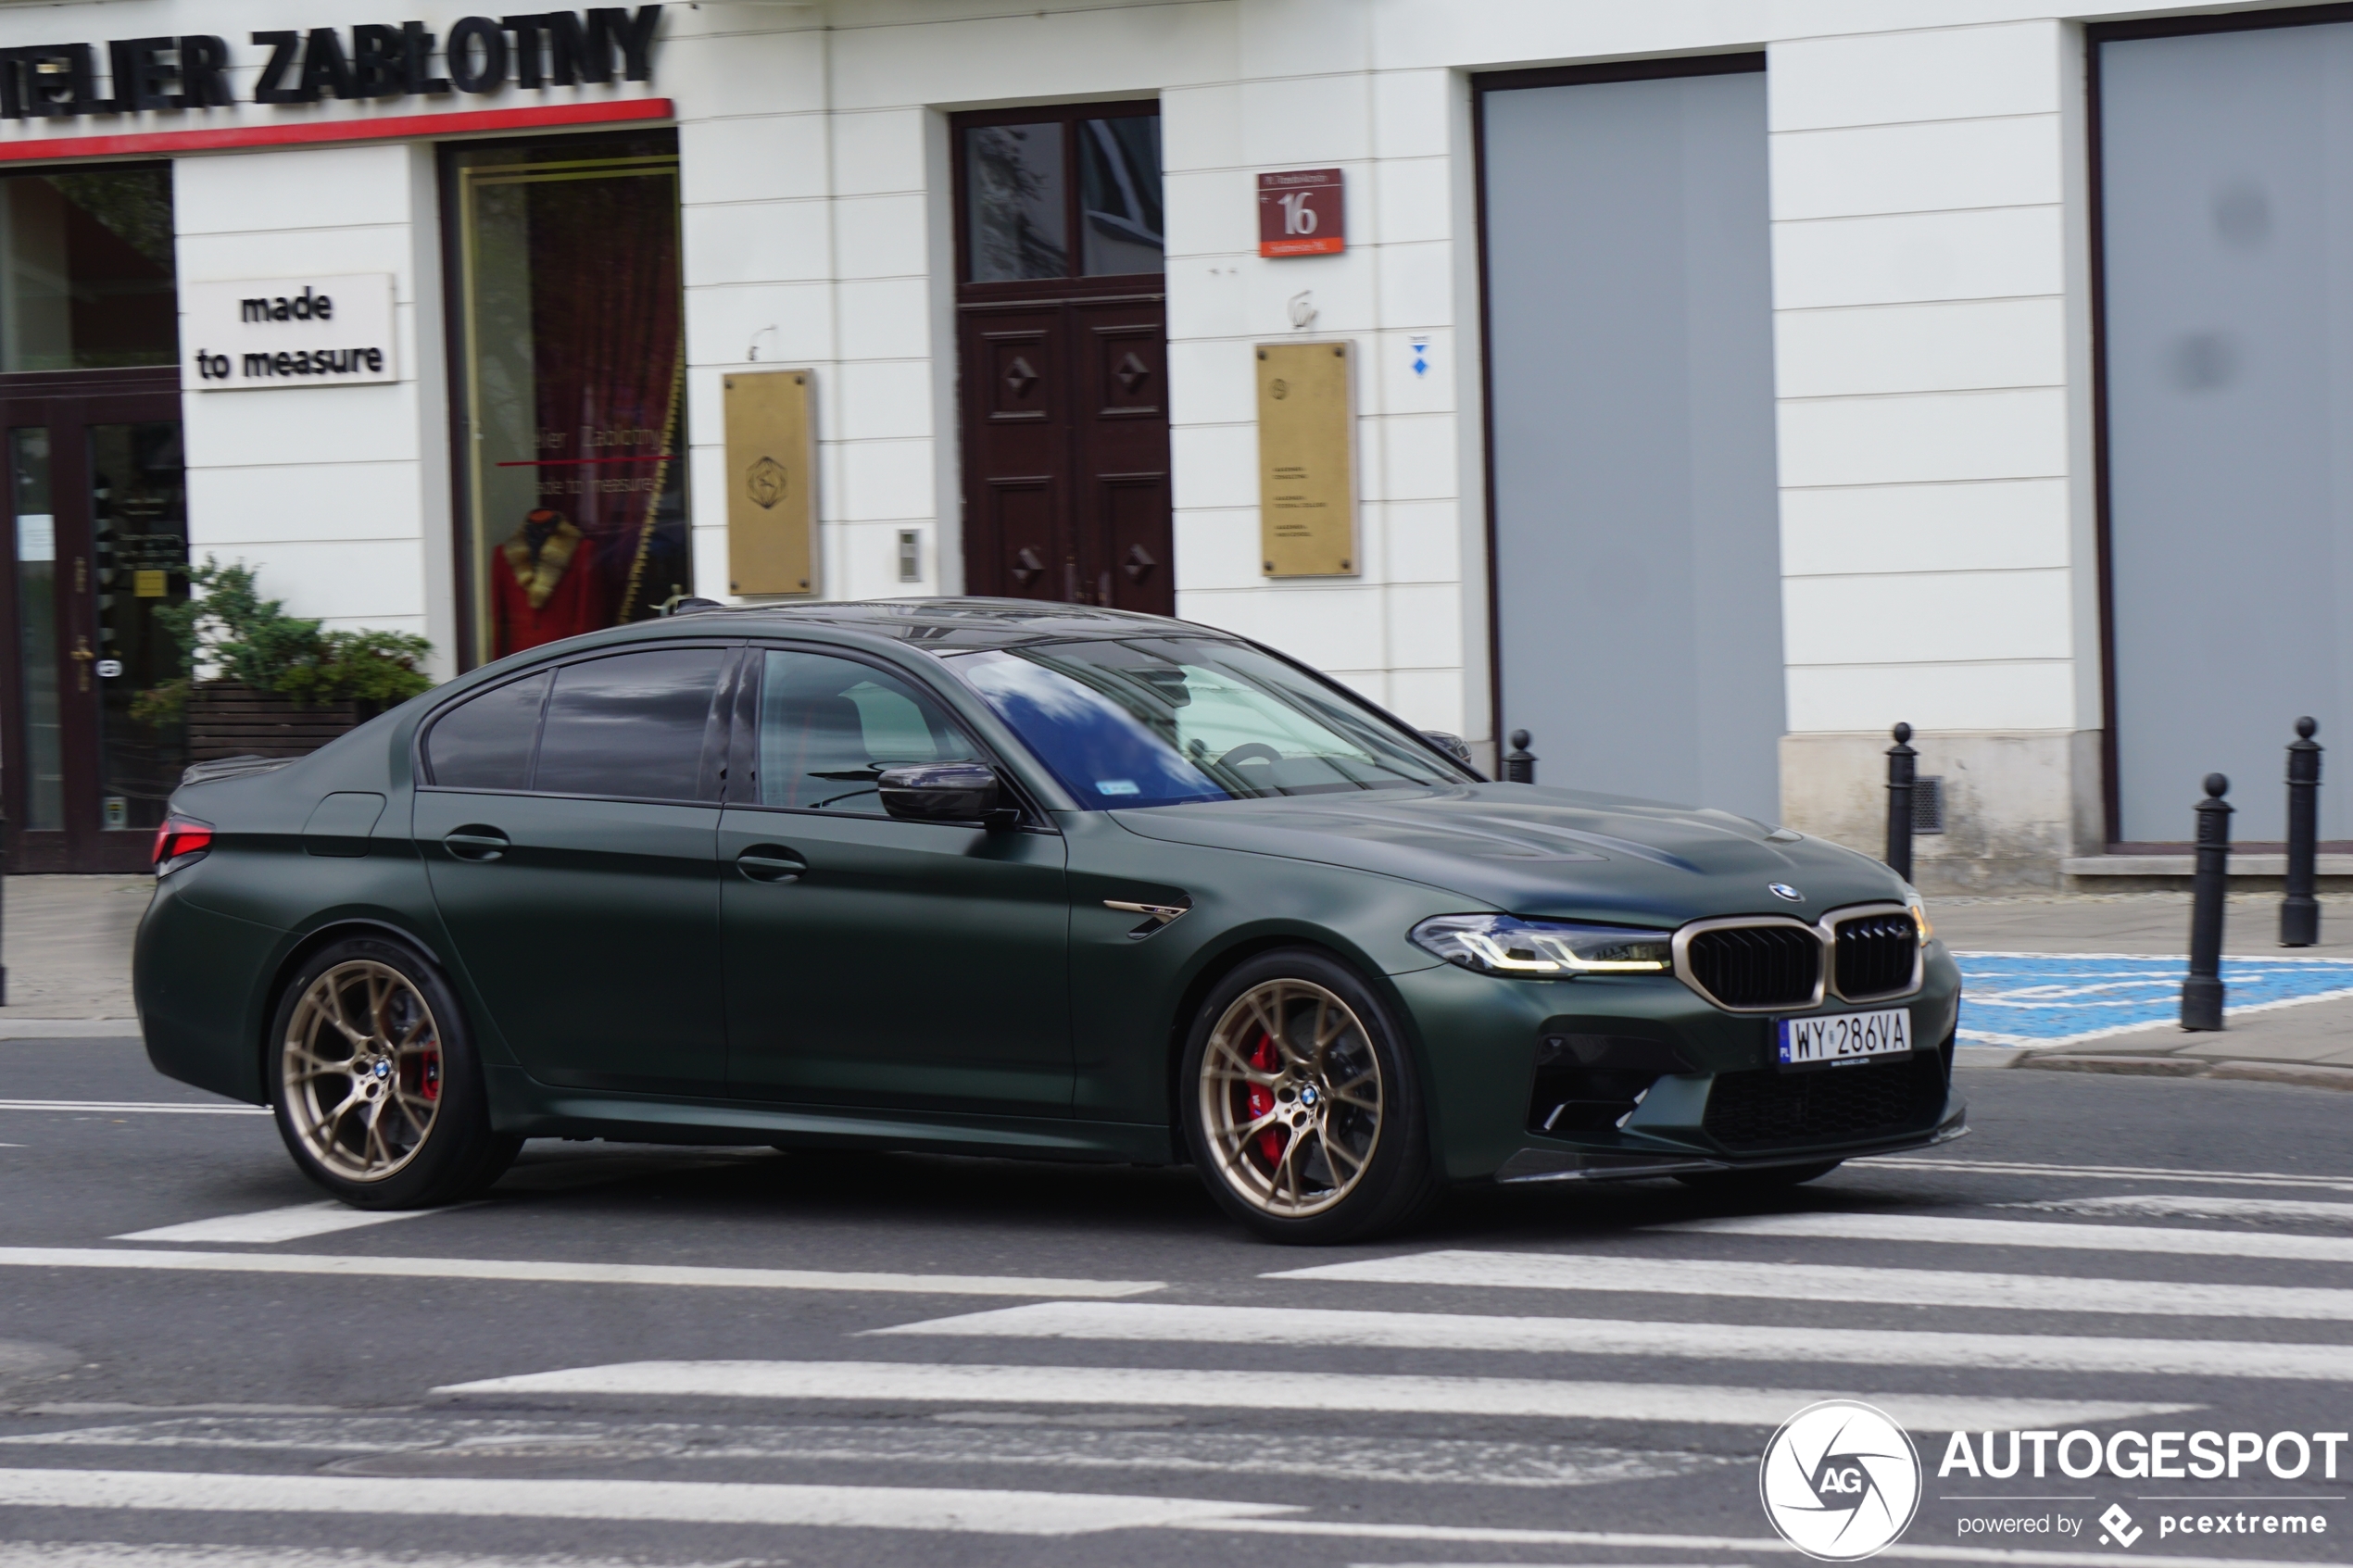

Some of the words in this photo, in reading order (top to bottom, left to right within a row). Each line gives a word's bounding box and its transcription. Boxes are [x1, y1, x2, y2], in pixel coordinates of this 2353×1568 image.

[251, 4, 662, 104] ZABŁOTNY
[1277, 192, 1318, 235] 16
[240, 285, 333, 323] made
[195, 348, 231, 380] to
[242, 346, 383, 378] measure
[1780, 1047, 1790, 1058] PL
[1795, 1021, 1826, 1060] WY
[1836, 1012, 1905, 1055] 286VA
